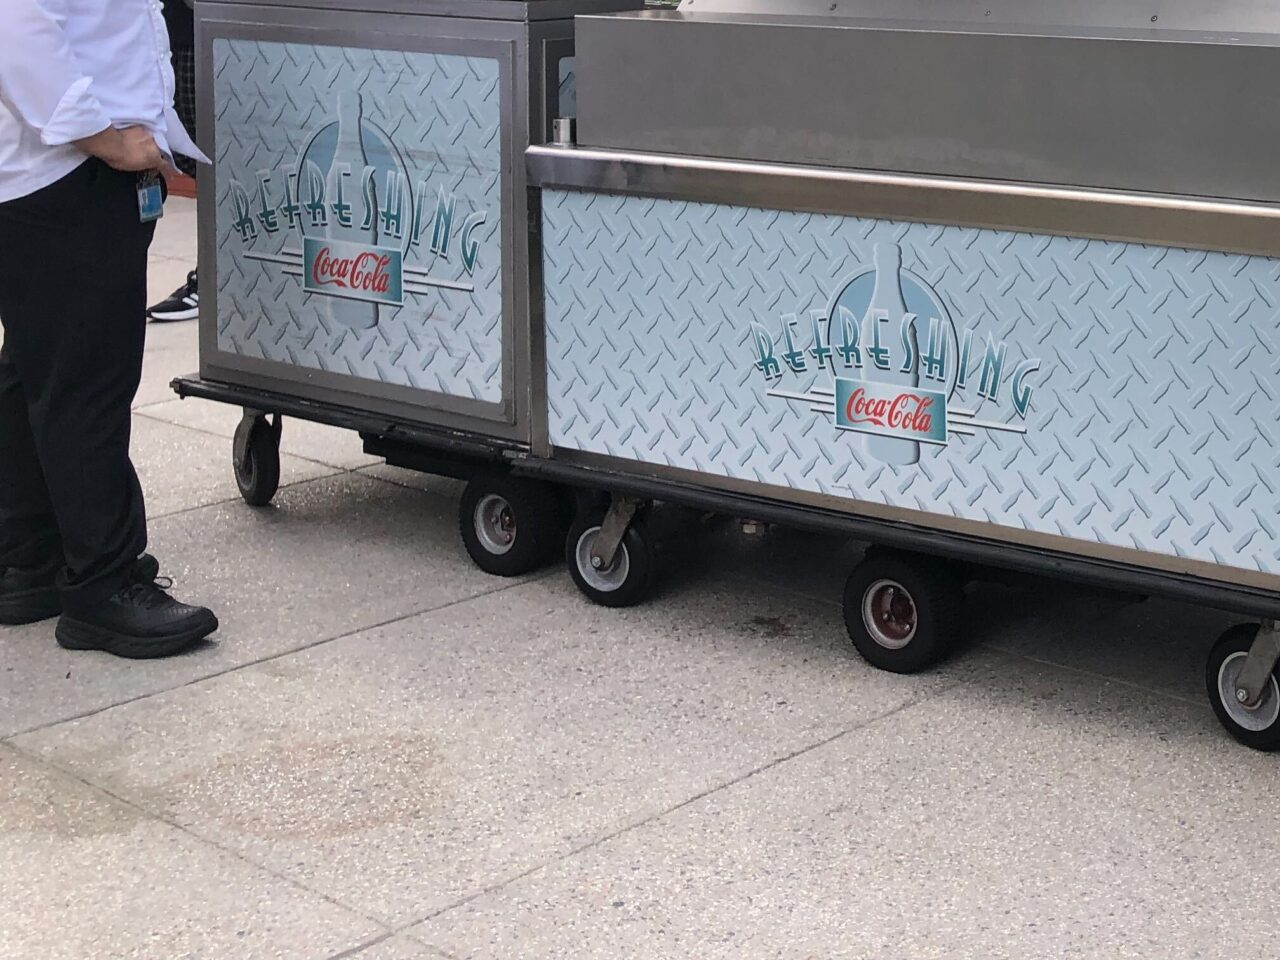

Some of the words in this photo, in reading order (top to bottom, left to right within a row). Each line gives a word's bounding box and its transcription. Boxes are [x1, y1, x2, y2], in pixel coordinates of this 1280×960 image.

[229, 159, 488, 277] REFRESHING
[312, 247, 394, 293] Coca-Cola
[750, 304, 1042, 420] REFRESHING
[845, 387, 934, 433] Coca-Cola
